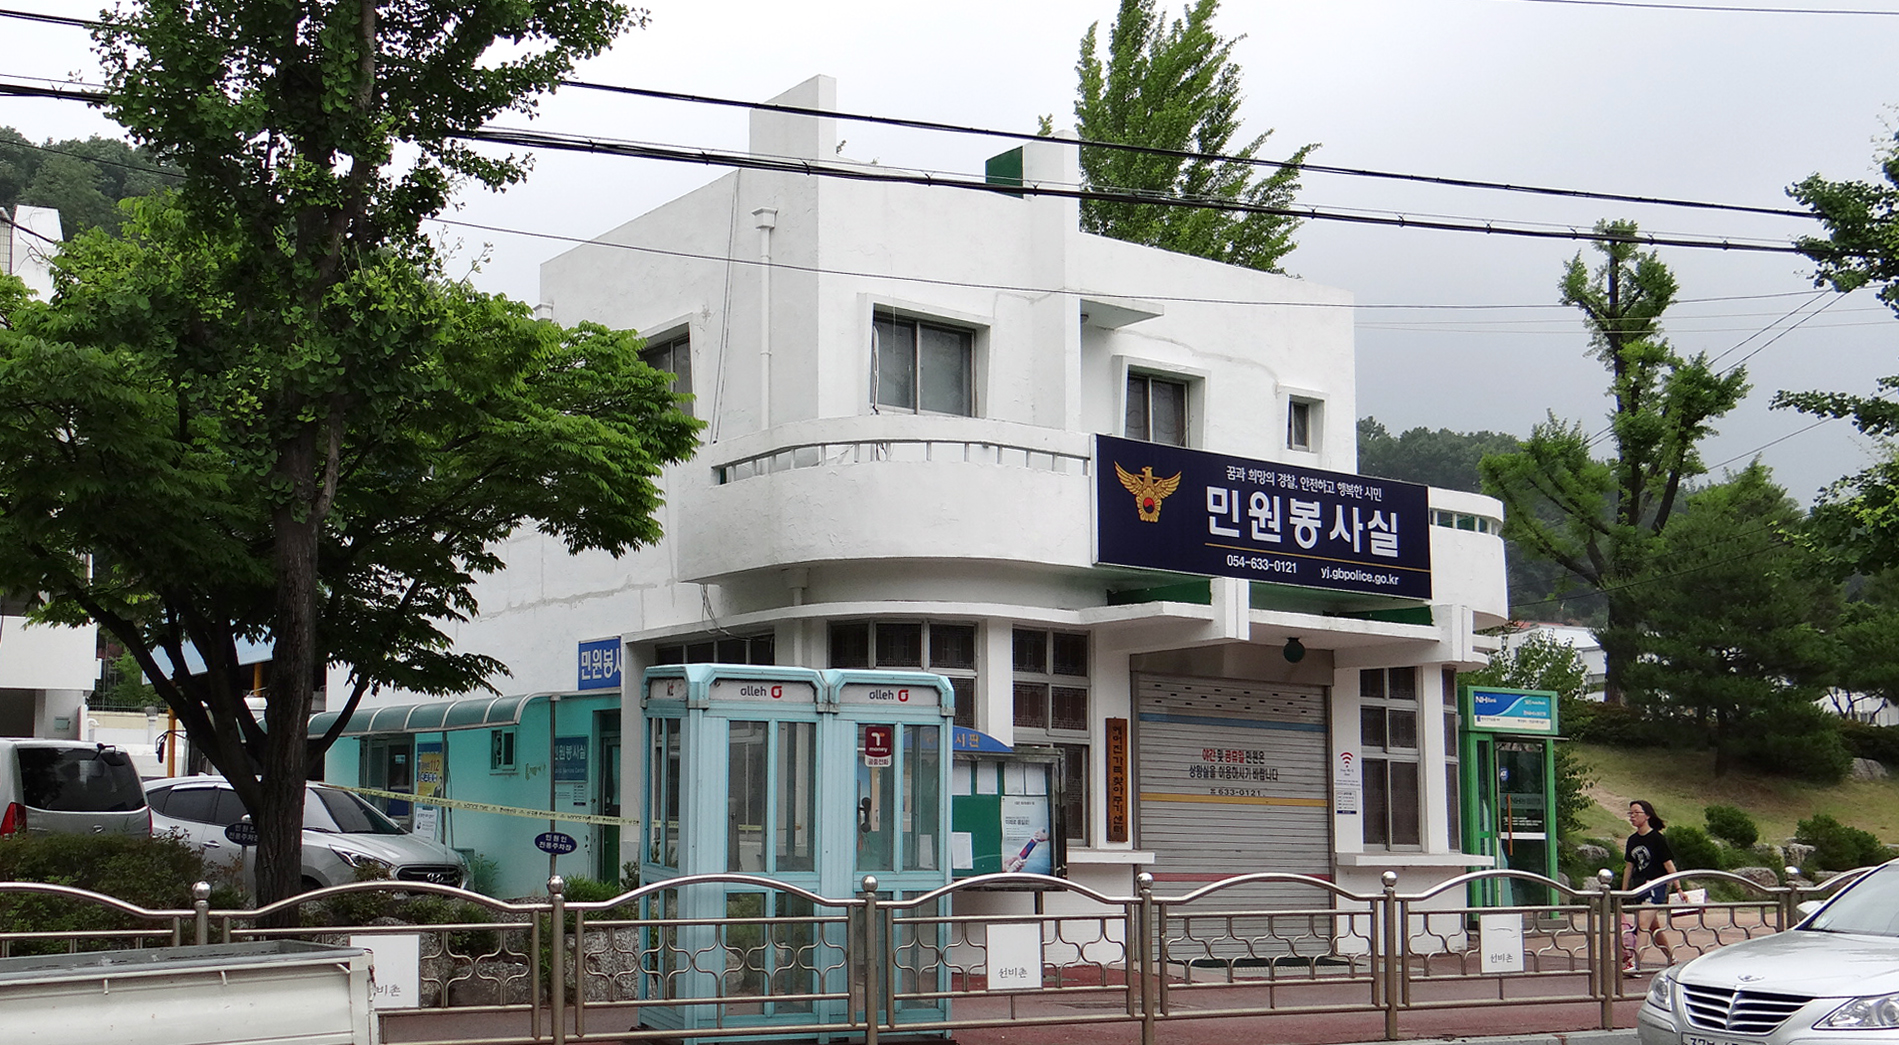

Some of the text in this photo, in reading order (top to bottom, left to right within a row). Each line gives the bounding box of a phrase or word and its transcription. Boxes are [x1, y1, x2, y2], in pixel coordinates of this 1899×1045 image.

[1226, 465, 1382, 502] 꿈과 희망의 경찰, 안전하고 행복한 시민
[1206, 485, 1399, 557] 민원봉사실
[1226, 554, 1297, 574] 054-633-0121
[1320, 566, 1399, 585] yj.gbpolice.go.kr
[740, 686, 766, 696] olleh
[869, 690, 894, 700] olleh
[1202, 748, 1216, 762] 야간
[1225, 749, 1244, 764] 공휴일
[1246, 750, 1265, 764] 민원은
[1189, 765, 1216, 778] 상황실을
[1252, 768, 1279, 781] 바랍니다
[1490, 953, 1513, 963] 선비촌
[998, 967, 1027, 978] 선비촌
[376, 984, 401, 997] 비촌
